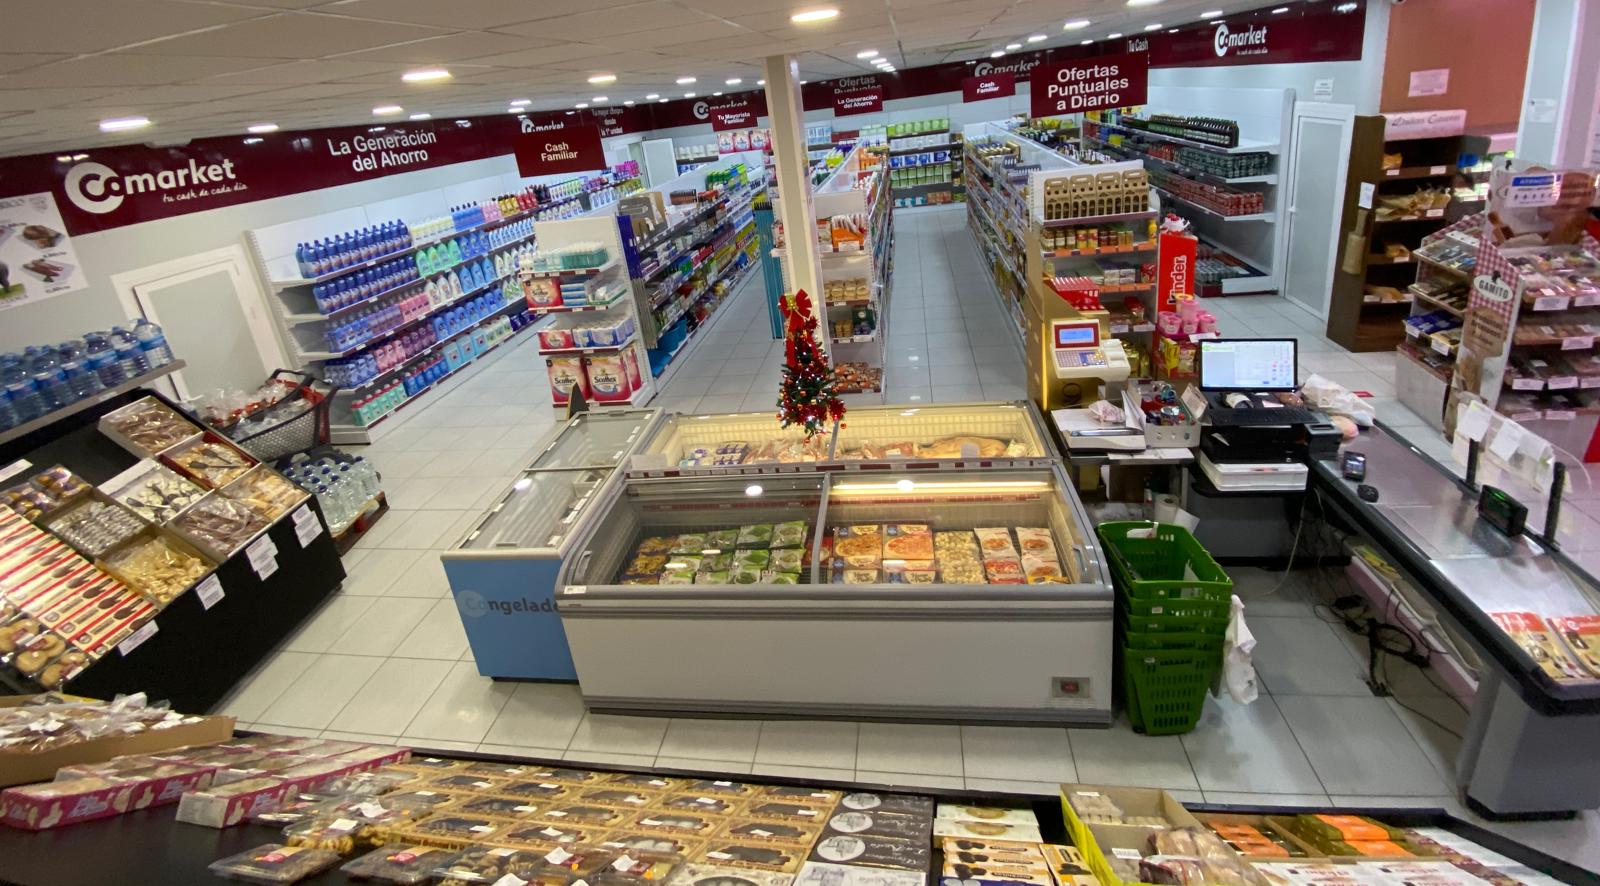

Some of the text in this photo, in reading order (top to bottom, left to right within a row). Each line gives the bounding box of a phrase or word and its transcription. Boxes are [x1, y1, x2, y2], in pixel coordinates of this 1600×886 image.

[838, 76, 876, 88] Ofertas
[1057, 65, 1119, 83] Ofertas
[976, 86, 1000, 94] Familiar
[1047, 78, 1129, 98] Puntuales
[1057, 92, 1120, 111] a Diario
[326, 129, 437, 156] La Generación
[544, 141, 569, 153] Cash
[352, 149, 429, 173] del Ahorro
[541, 151, 578, 162] Familiar
[1478, 279, 1509, 300] GAMITO
